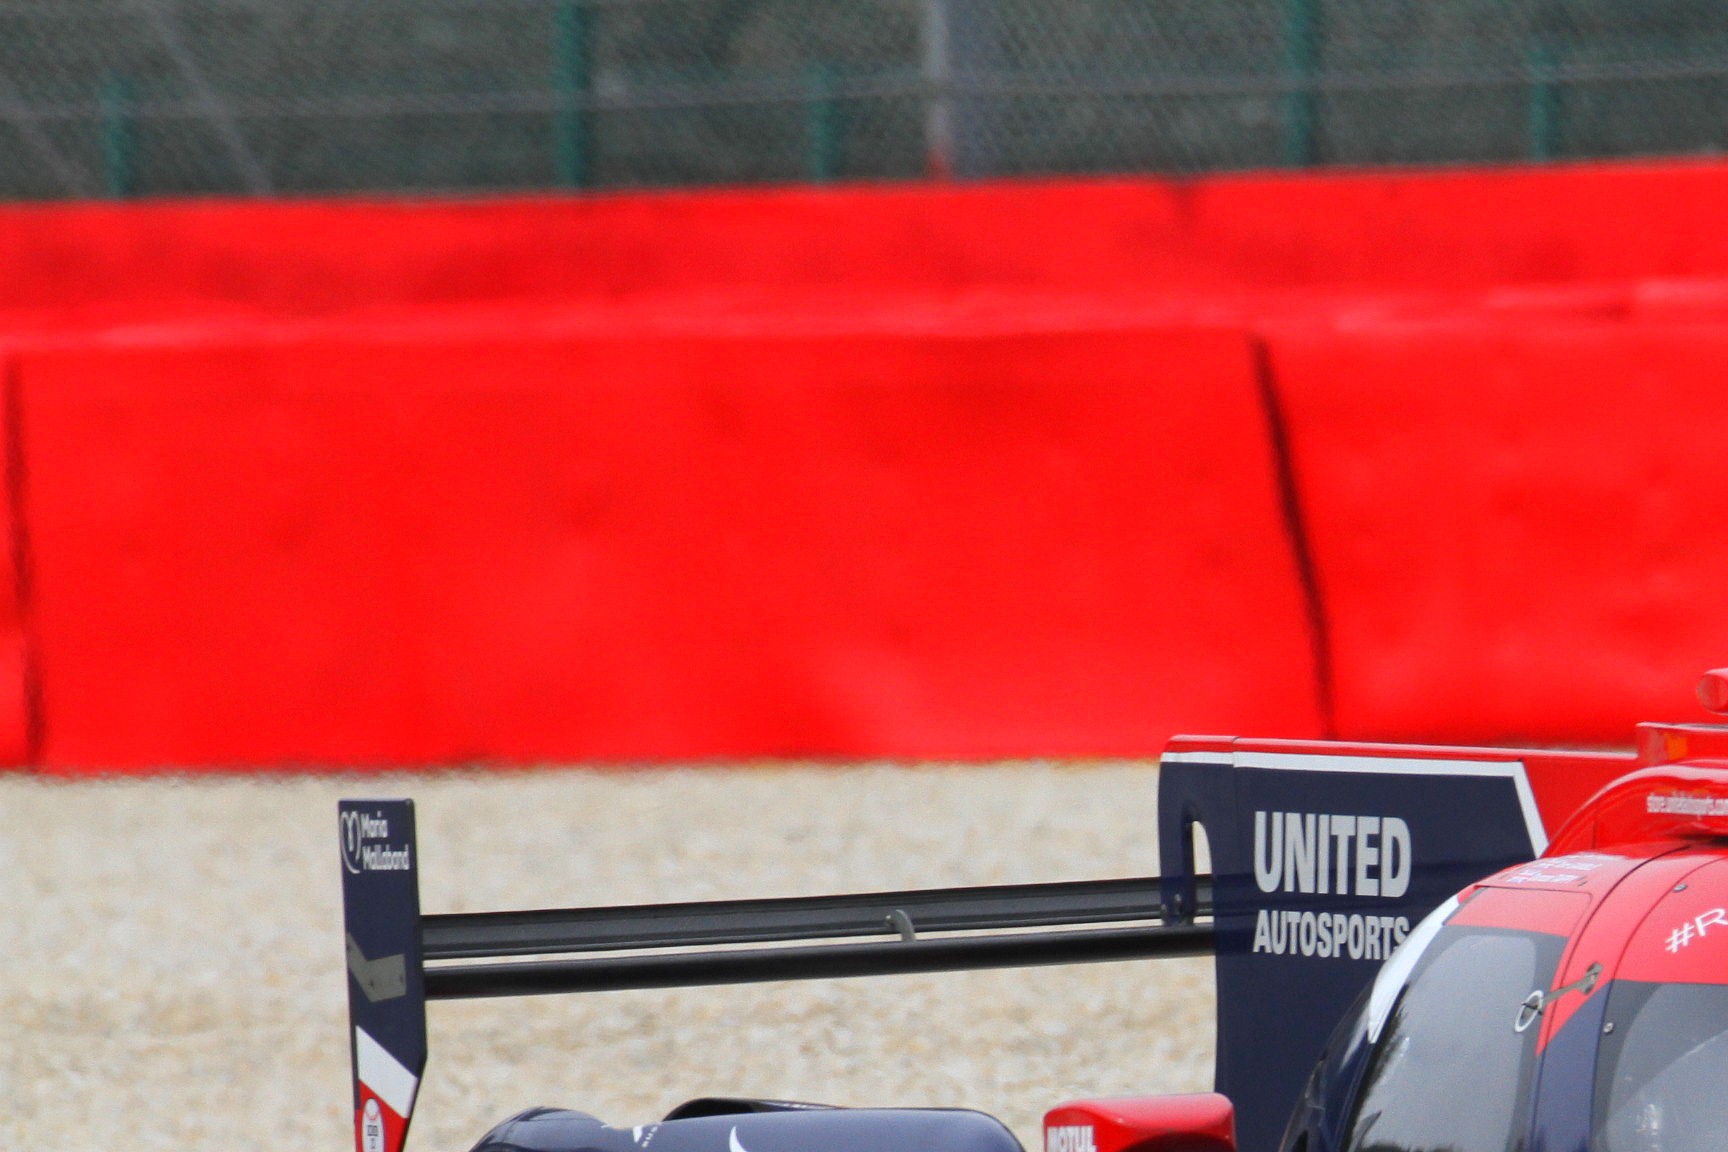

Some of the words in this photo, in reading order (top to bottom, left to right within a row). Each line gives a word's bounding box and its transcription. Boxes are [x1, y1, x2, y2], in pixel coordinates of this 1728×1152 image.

[361, 810, 388, 838] Maria
[362, 844, 410, 870] Mallaband
[1254, 811, 1412, 898] UNITED
[1253, 909, 1412, 961] AUTOSPORTS
